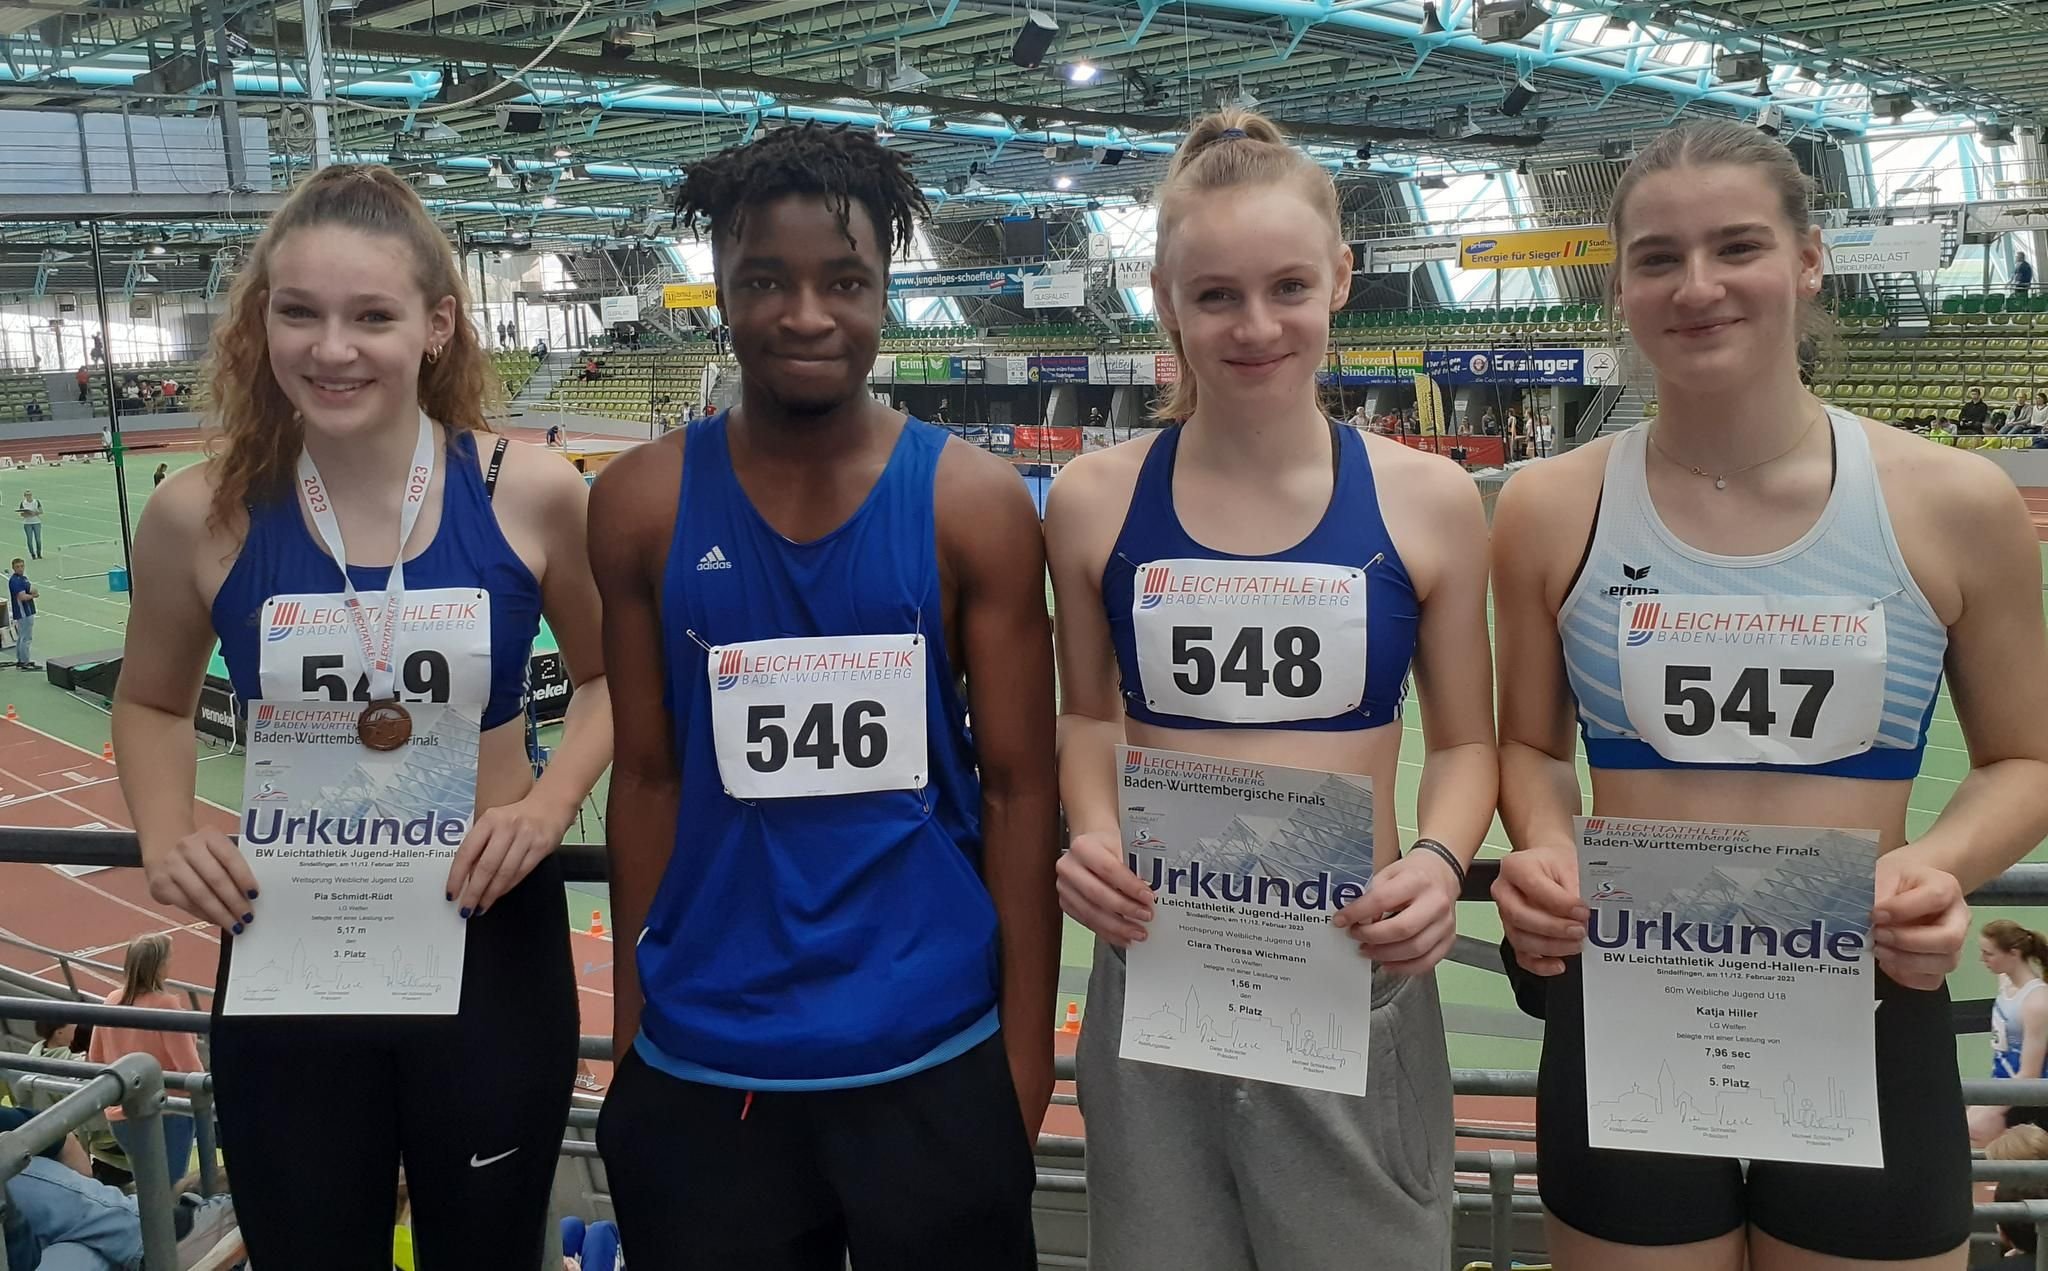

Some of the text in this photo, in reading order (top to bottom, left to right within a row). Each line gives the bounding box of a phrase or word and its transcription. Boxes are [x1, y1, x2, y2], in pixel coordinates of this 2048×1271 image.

[1589, 239, 1612, 247] Stadt
[1472, 250, 1560, 264] Energie für Sieger
[1835, 252, 1910, 264] GLASPALAST
[1835, 264, 1885, 272] SINDELFINGEN
[1492, 354, 1579, 375] Ensinger
[487, 464, 498, 482] NIKE
[408, 466, 428, 503] 2023
[304, 475, 327, 513] 2023
[697, 561, 732, 571] adidas
[1169, 575, 1352, 594] LEICHTATHLETIK
[1609, 584, 1659, 596] erima
[299, 603, 478, 625] LEICTHLETIK
[1660, 612, 1869, 634] LEICHTATHLETIK
[541, 659, 555, 680] 2
[744, 650, 914, 673] LEICHTATHLETIK
[1172, 626, 1322, 698] 548
[1663, 665, 1835, 739] 547
[202, 706, 234, 728] venneke
[254, 731, 439, 746] Baden-Württembe Finals
[746, 700, 888, 773] 546
[1143, 756, 1265, 779] LEICHTATHLETIK
[1124, 775, 1326, 806] Baden-Württembergische Finals
[245, 808, 465, 846] Urkunde
[1606, 823, 1751, 837] LEICHTATHLETIK
[255, 849, 457, 859] BW Leichtathletik Jugend-Hallen-Finals
[1584, 836, 1820, 857] Baden-Württembergische Finals
[1128, 852, 1364, 911] Urkunde
[314, 892, 393, 901] Pia Schmidt-Rüdt
[1162, 897, 1235, 914] Leichtathletik
[1238, 906, 1332, 925] Jugend-Hallen-F
[1186, 911, 1227, 923] Sindelfingen,
[1262, 921, 1287, 929] Februar
[337, 926, 355, 935] 5,17
[1179, 924, 1311, 949] Hochsprung Weibliche Jugend U18
[1587, 908, 1864, 962] Urkunde
[333, 950, 367, 958] 3. Platz
[1187, 939, 1307, 964] Clara Theresa Wichmann
[1604, 952, 1860, 976] BW Leichtathletik Jugend-Hallen-Finals
[1231, 978, 1262, 991] 1,56 m
[1253, 970, 1278, 981] Leistung
[1657, 968, 1705, 978] Sindelfingen,
[1746, 973, 1775, 982] Februar
[1776, 975, 1795, 983] 2023
[1664, 986, 1787, 1001] 60m Weibliche Jugend U18
[1228, 1003, 1263, 1017] 5. Platz
[1696, 1006, 1758, 1018] Katja Hiller
[1676, 1032, 1702, 1042] belegte
[1735, 1035, 1766, 1045] Leistung
[1705, 1047, 1751, 1059] 7,96 sec
[1709, 1077, 1750, 1088] 5. Platz
